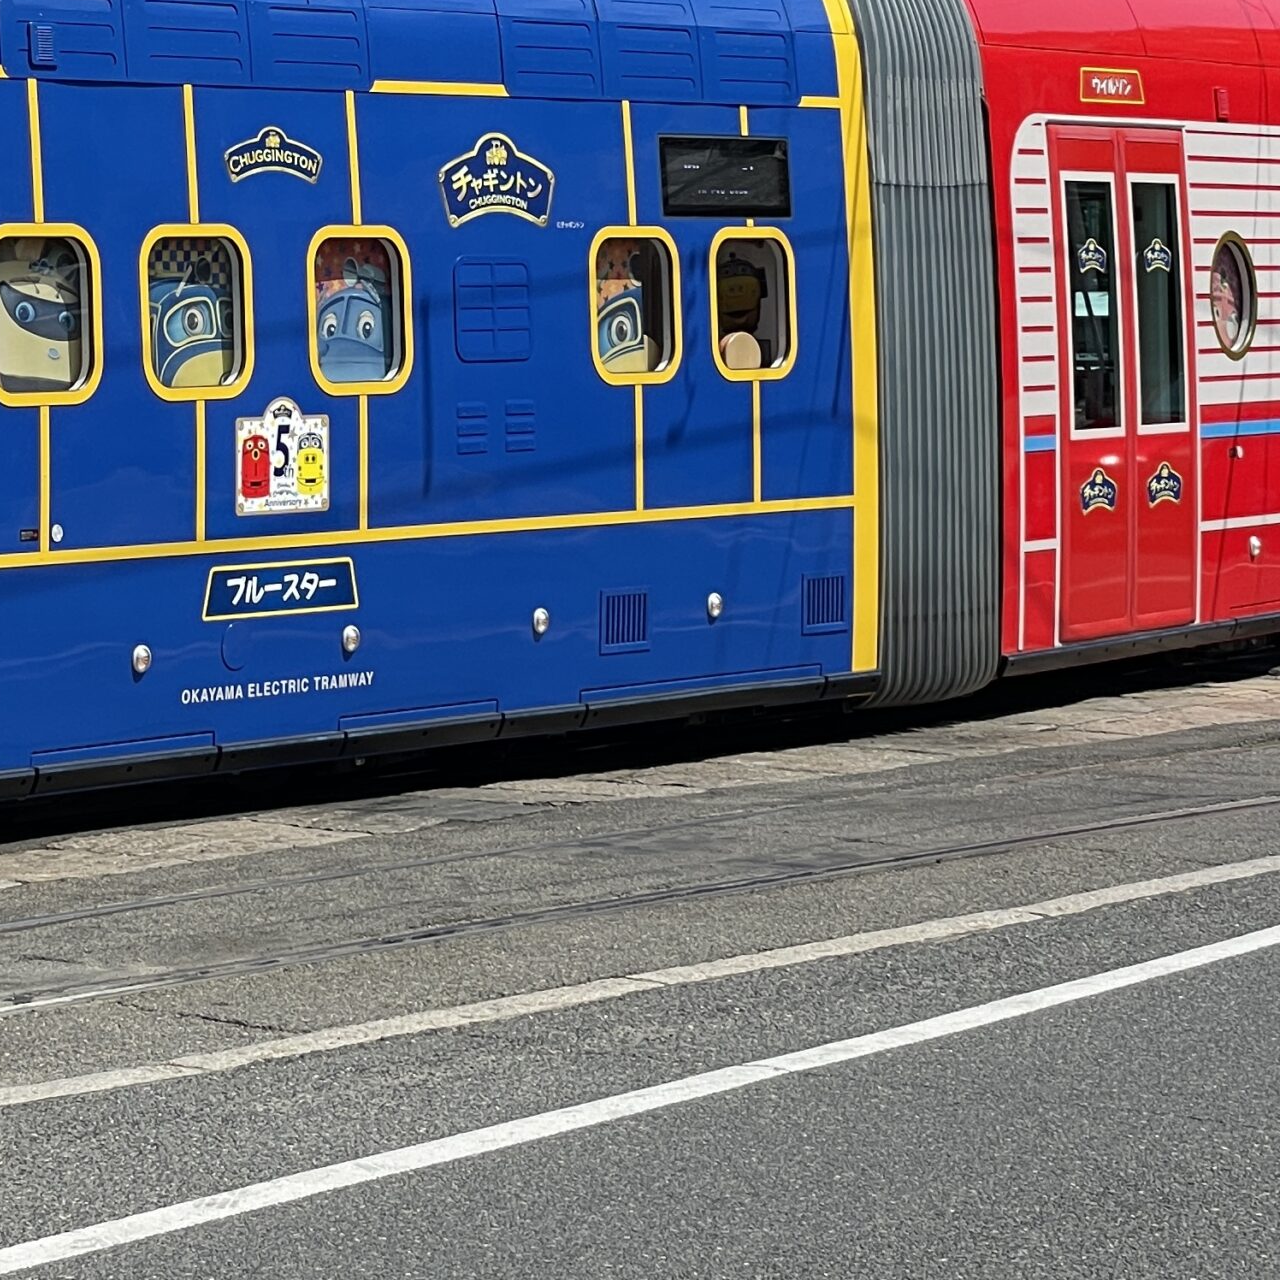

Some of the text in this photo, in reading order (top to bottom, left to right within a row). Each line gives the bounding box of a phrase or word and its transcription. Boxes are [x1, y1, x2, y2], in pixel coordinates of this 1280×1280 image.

[229, 149, 318, 174] CHUGGINGTON
[451, 165, 542, 202] チャギントン
[469, 194, 528, 210] CHUGGINGTON
[227, 571, 337, 606] ブルースター
[181, 671, 375, 704] OKAYAMA ELECTRIC TRAMWAY
